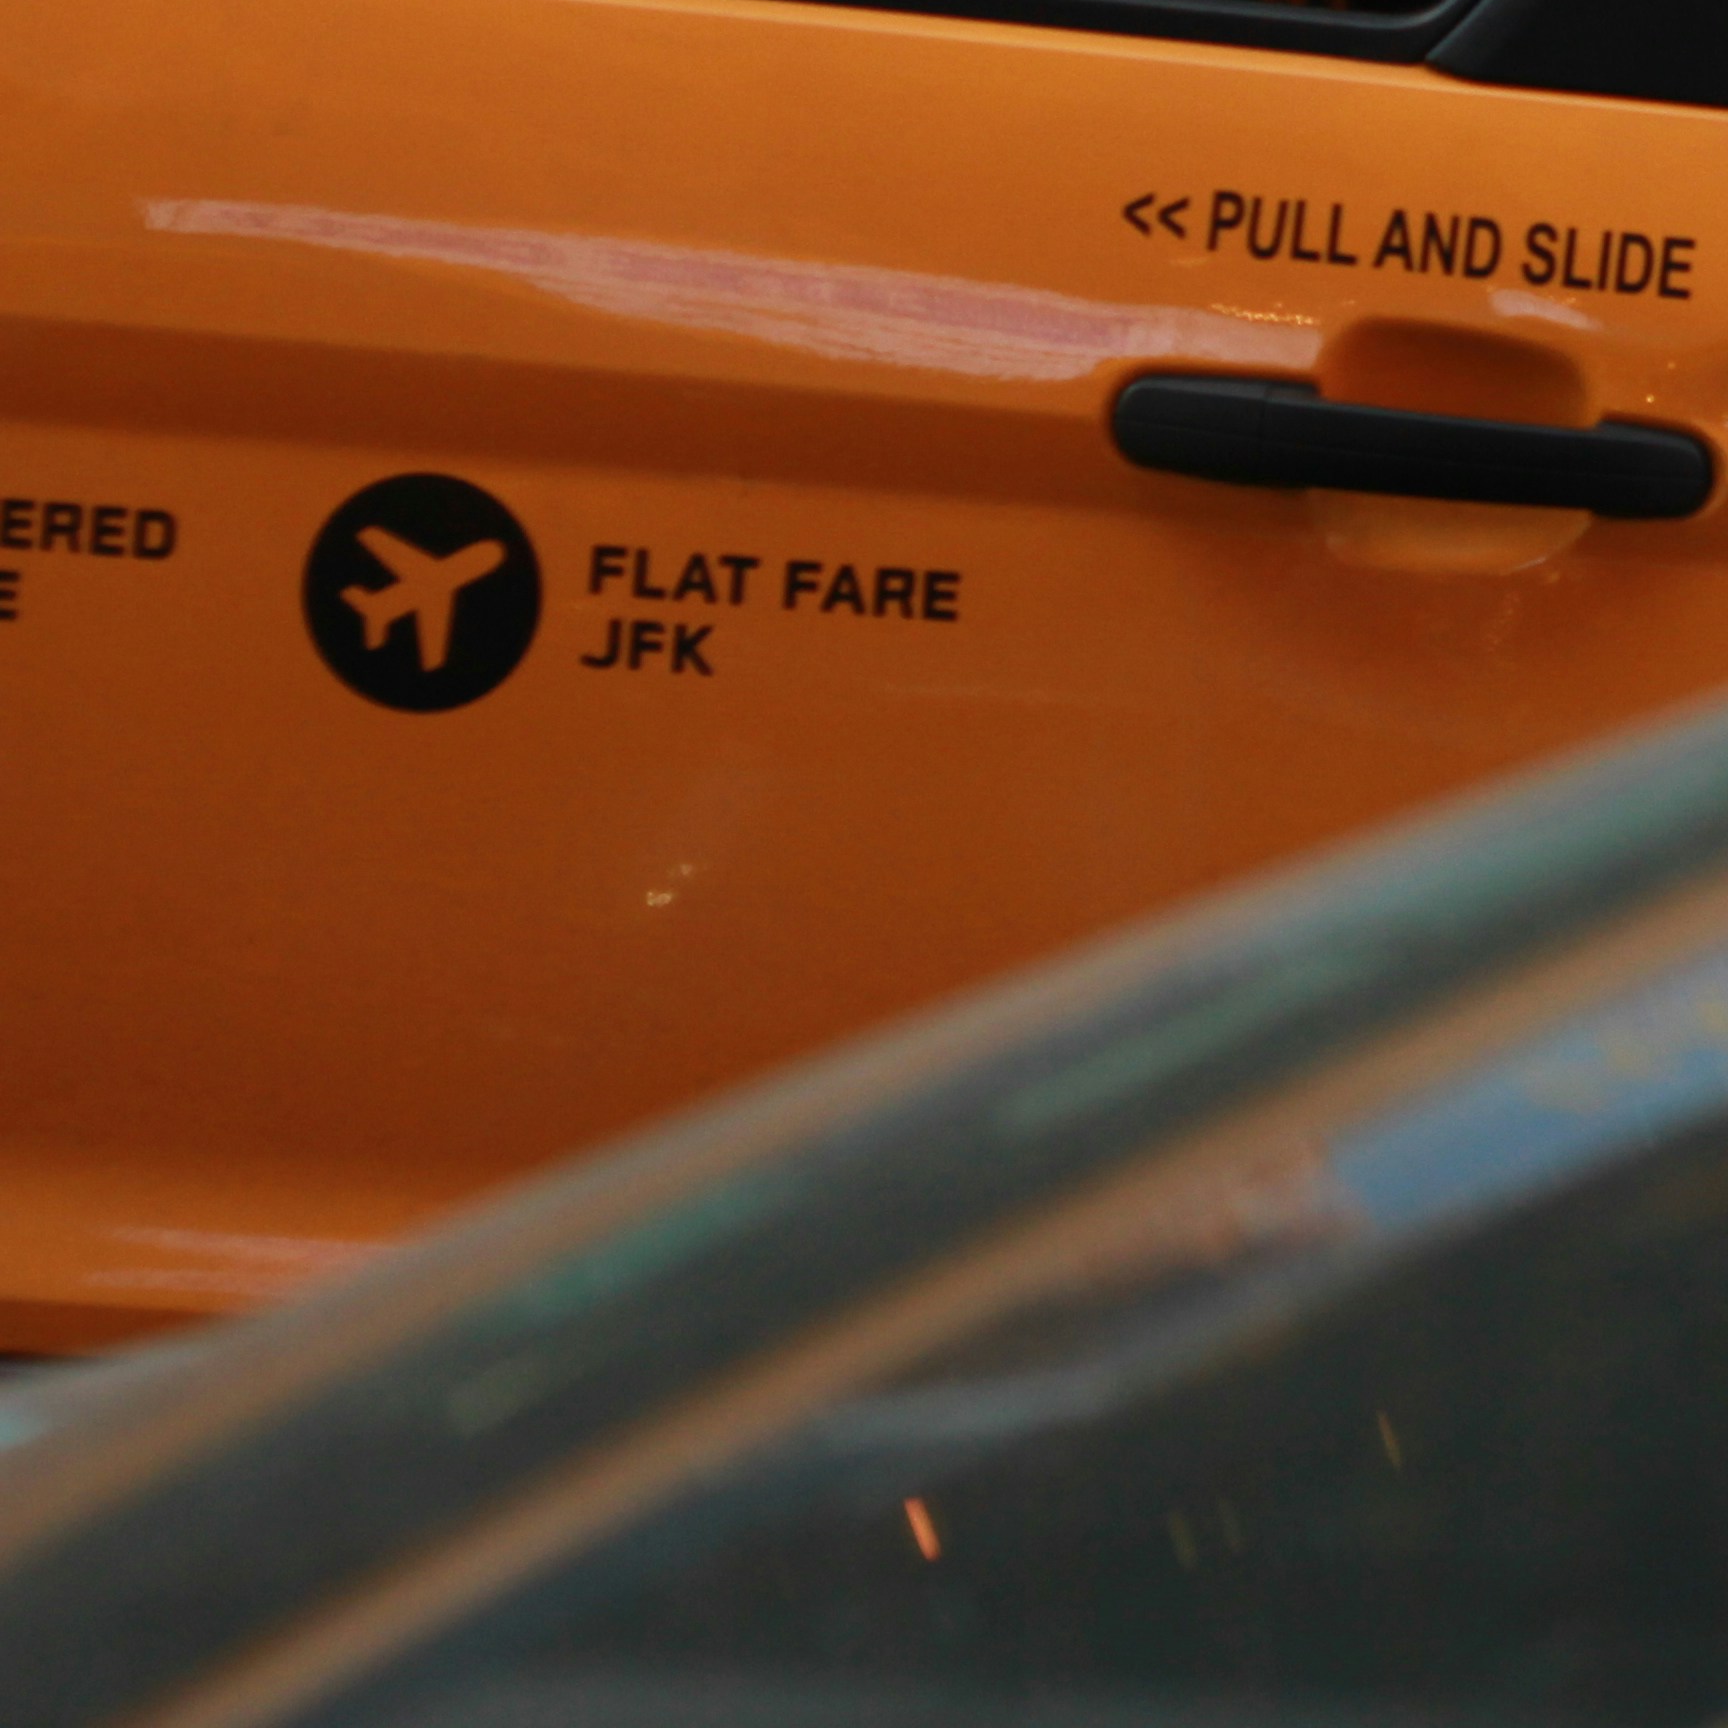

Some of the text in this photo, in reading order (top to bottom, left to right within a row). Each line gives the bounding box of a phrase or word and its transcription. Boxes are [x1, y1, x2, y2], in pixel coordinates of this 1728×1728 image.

[1206, 190, 1696, 300] PULL AND SLIDE
[0, 498, 177, 561] ERED
[587, 544, 960, 622] FLAT FARE
[579, 618, 714, 676] JFK
